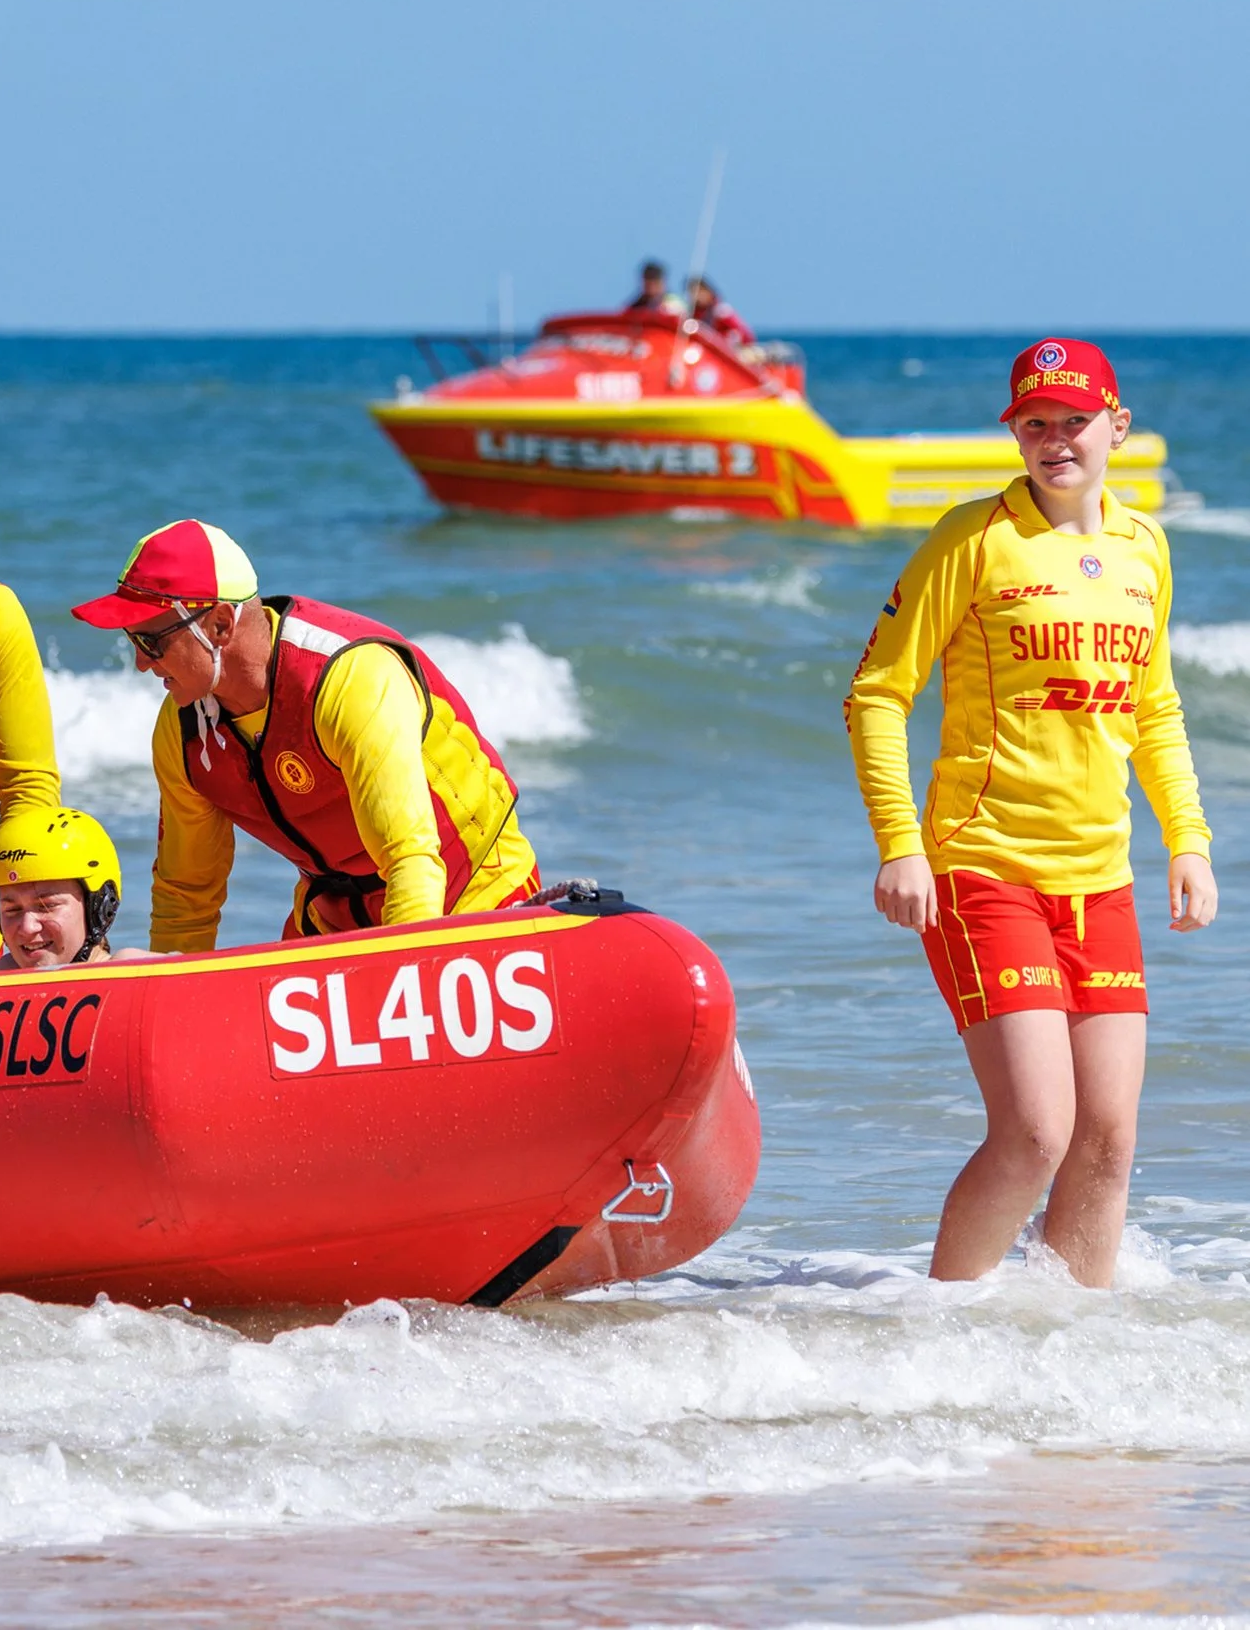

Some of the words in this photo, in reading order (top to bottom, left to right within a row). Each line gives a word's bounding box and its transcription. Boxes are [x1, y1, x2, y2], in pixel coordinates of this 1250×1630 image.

[1017, 372, 1041, 398] SURF
[1042, 370, 1090, 391] RESCUE
[476, 429, 719, 475] LIFESAVER
[726, 440, 757, 476] 2
[990, 584, 1068, 601] DHL
[1009, 621, 1084, 661] SURF
[1022, 966, 1052, 986] SURF
[1078, 972, 1146, 989] DHL
[268, 950, 554, 1074] SL40S
